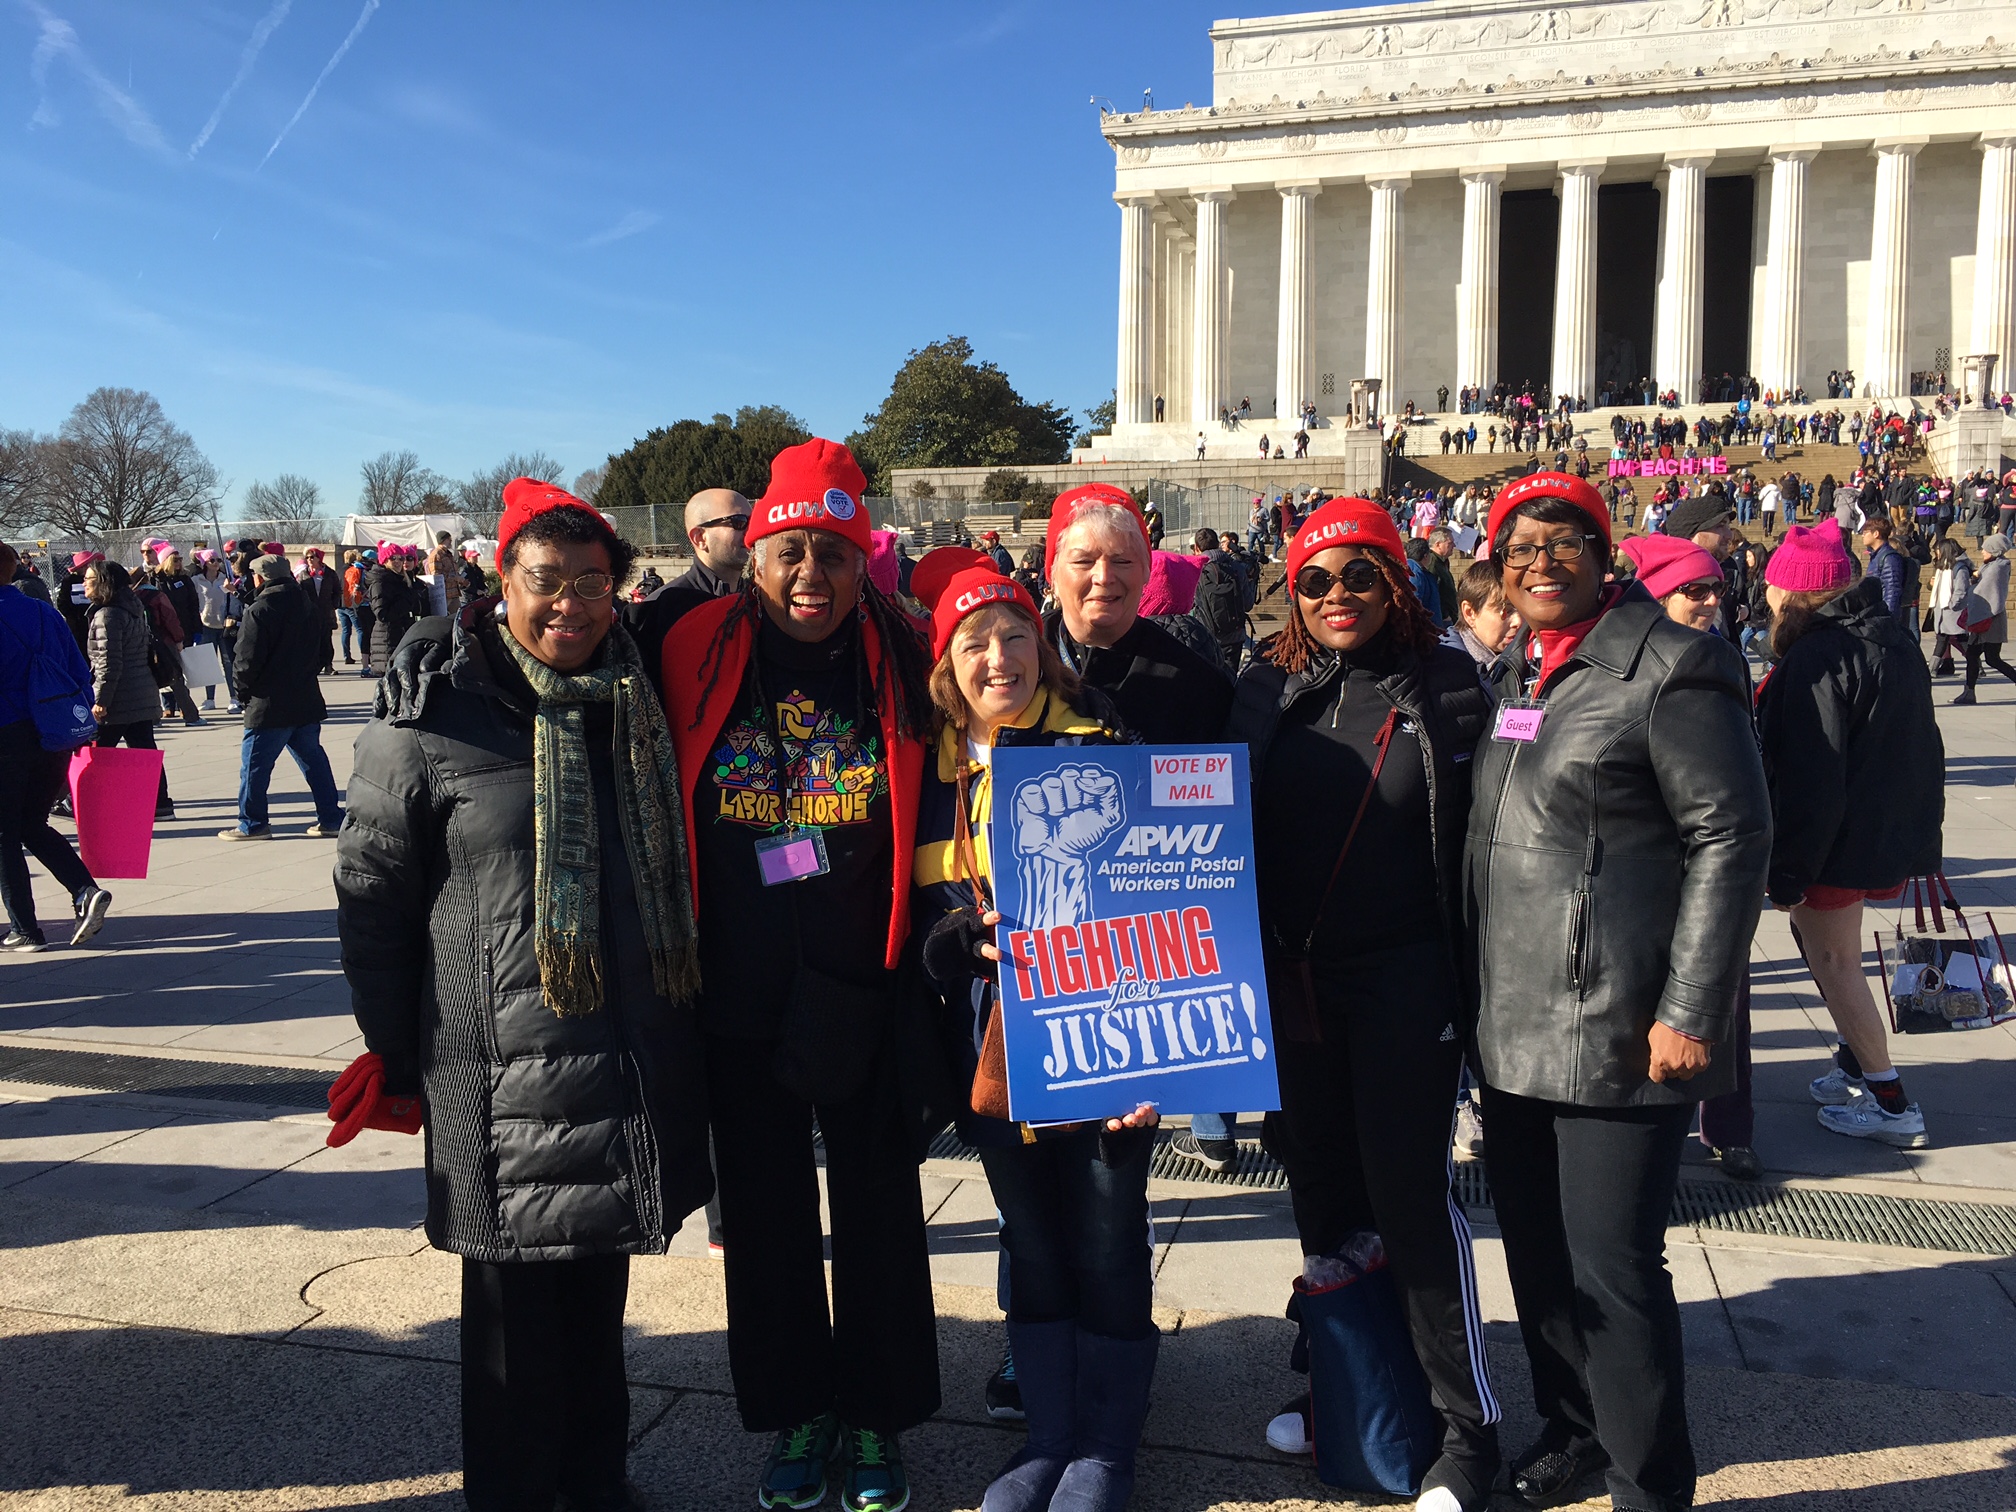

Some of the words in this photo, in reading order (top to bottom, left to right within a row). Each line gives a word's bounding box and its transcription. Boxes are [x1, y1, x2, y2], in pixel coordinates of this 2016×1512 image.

[1745, 29, 1770, 39] WEST
[1774, 26, 1816, 36] VIRGINIA
[1828, 22, 1864, 32] NEVADA
[1650, 36, 1689, 47] OREGON
[1699, 33, 1735, 43] KANSAS
[1519, 46, 1574, 58] CALIFORNIA
[1585, 41, 1640, 52] MINNESOTA
[1421, 58, 1447, 67] IOWA
[1457, 52, 1511, 63] WISCONSIN
[1281, 68, 1325, 79] MICHIGAN
[1334, 65, 1370, 74] FLORIDA
[1382, 61, 1409, 71] TEXAS
[1229, 73, 1272, 83] ARKANSAS
[1507, 478, 1571, 499] CLUW
[768, 501, 826, 524] CLUW
[1304, 520, 1358, 548] CLUW
[955, 584, 1017, 612] CLUW
[1506, 719, 1532, 731] Guest
[1154, 758, 1201, 775] VOTE
[1205, 757, 1227, 773] BY
[1169, 783, 1215, 800] MAIL
[720, 789, 780, 823] LABOR
[1115, 824, 1224, 856] APWU
[1097, 858, 1186, 876] American
[1189, 857, 1244, 872] Postal
[1109, 875, 1181, 892] Workers
[1185, 875, 1236, 890] Union
[1008, 905, 1221, 1002] FIGHTING
[1102, 965, 1160, 1012] for
[1043, 982, 1267, 1079] JUSTICE!
